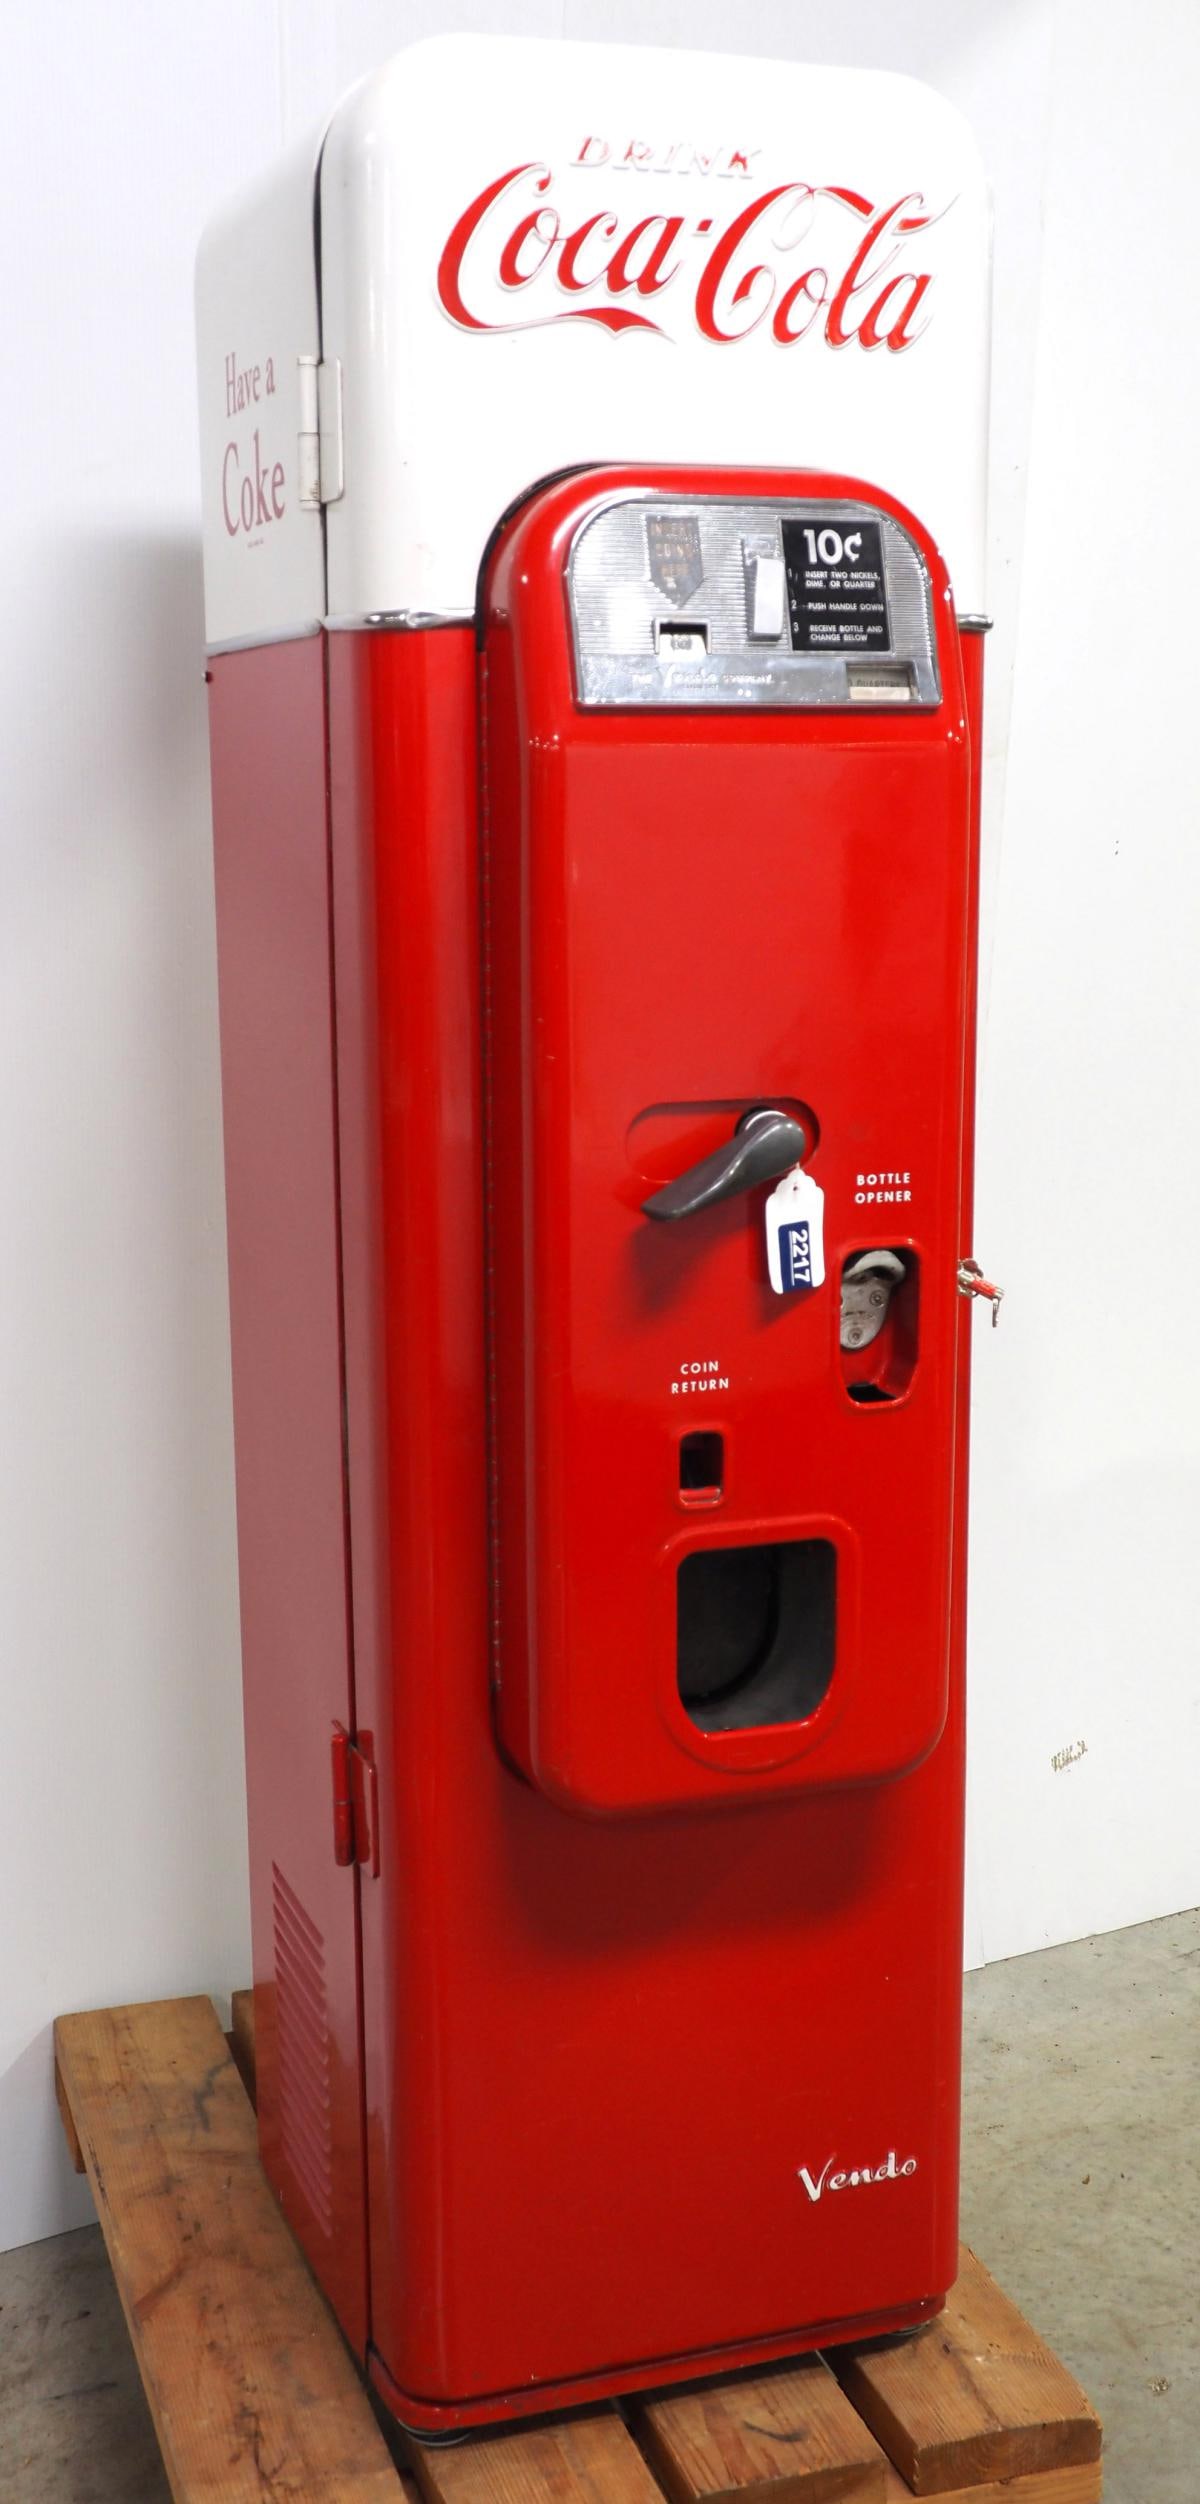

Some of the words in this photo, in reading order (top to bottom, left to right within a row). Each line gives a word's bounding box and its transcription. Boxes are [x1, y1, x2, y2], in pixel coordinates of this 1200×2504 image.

[569, 136, 762, 179] DRINK
[433, 160, 955, 353] Coca-Cola
[225, 351, 261, 418] Have
[265, 357, 276, 395] a
[222, 427, 286, 537] Coke
[805, 571, 828, 579] INSERT
[831, 571, 848, 579] TWO
[830, 580, 841, 588] OR
[844, 581, 876, 589] QUARTER
[791, 600, 797, 610] 2
[829, 603, 857, 611] HANDLE
[860, 603, 884, 612] DOWN
[793, 622, 799, 633] 3
[809, 625, 837, 633] RECEIVE
[840, 625, 864, 633] BOTTLE
[866, 625, 883, 634] AND
[810, 633, 841, 642] CHANGE
[843, 634, 868, 642] BELOW
[856, 1172, 911, 1186] BOTTLE
[855, 1190, 912, 1204] OPENER
[791, 1229, 811, 1282] 2217
[680, 1361, 719, 1375] COIN
[671, 1378, 729, 1394] RETURN
[797, 2152, 917, 2202] Vendo
